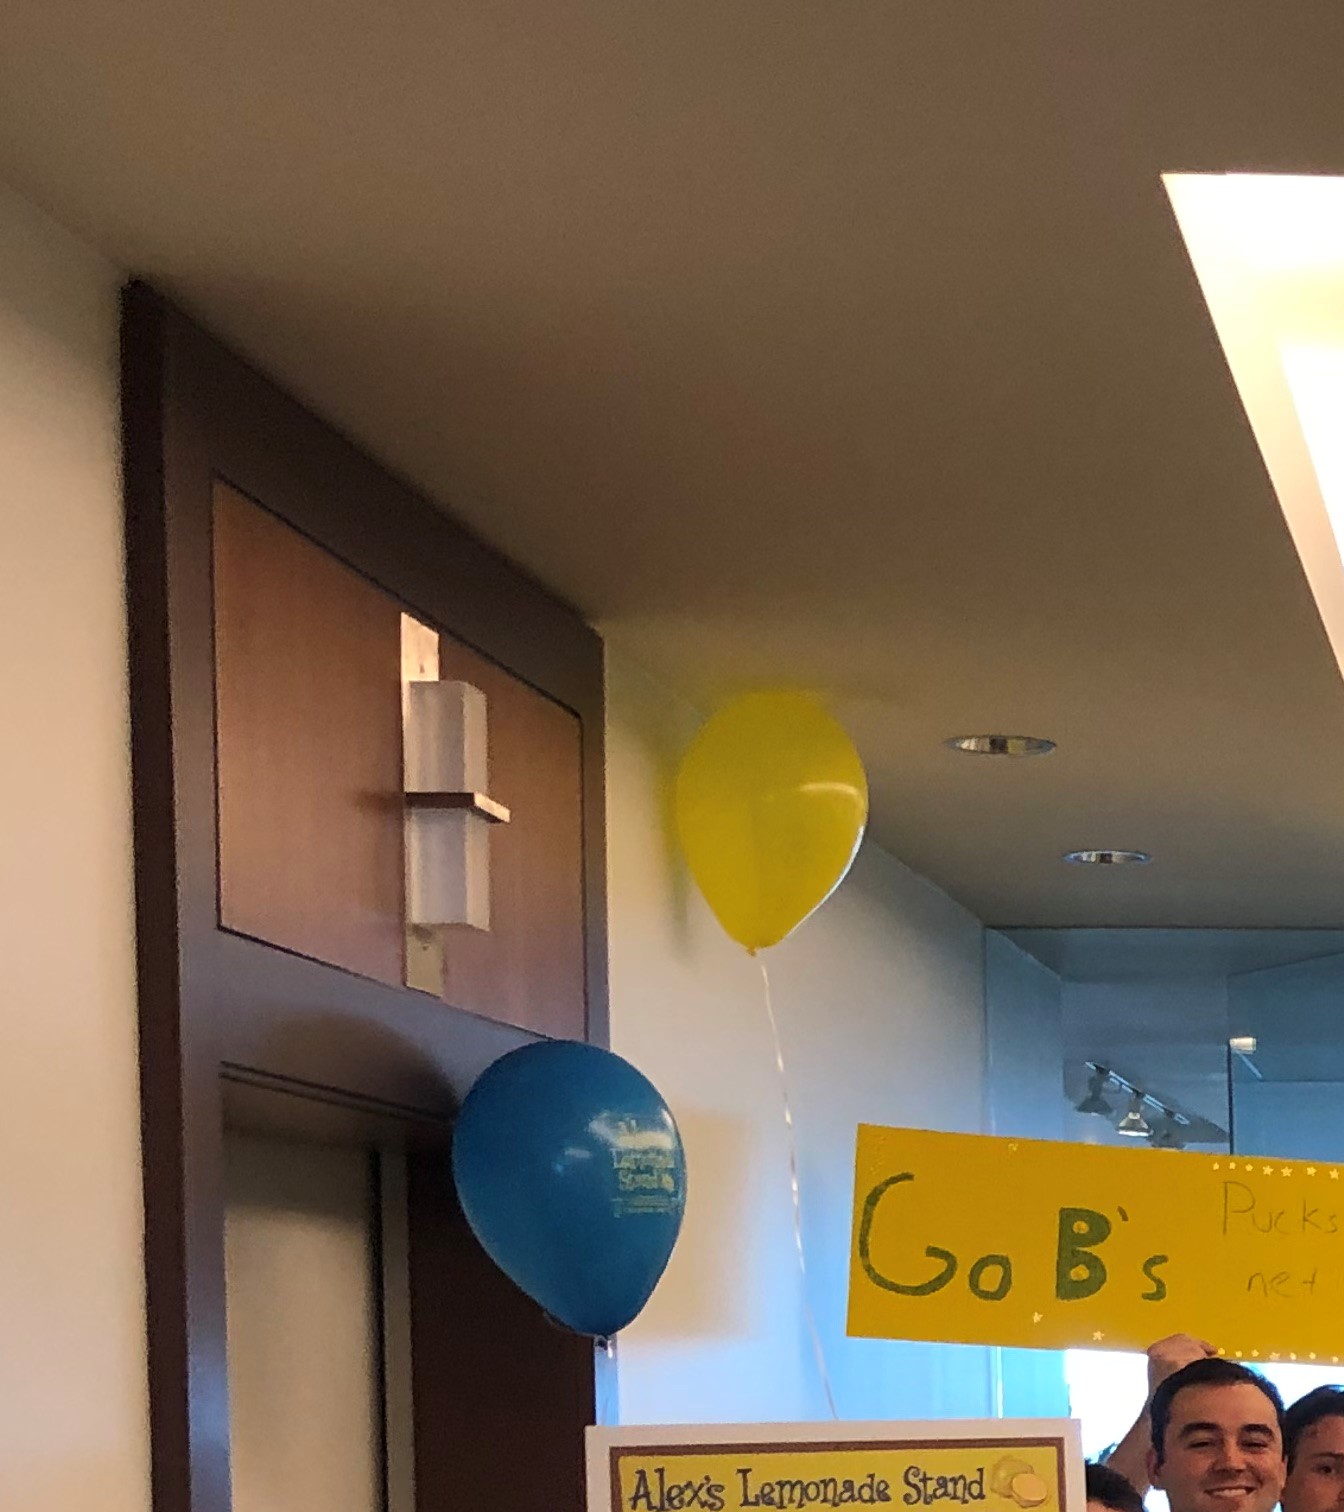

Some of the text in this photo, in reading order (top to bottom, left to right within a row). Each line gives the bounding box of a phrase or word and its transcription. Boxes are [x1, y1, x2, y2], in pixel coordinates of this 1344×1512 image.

[1223, 1180, 1338, 1236] Pucks
[859, 1172, 1168, 1301] Go B's
[630, 1463, 987, 1512] Alex's Lemonade Stand
